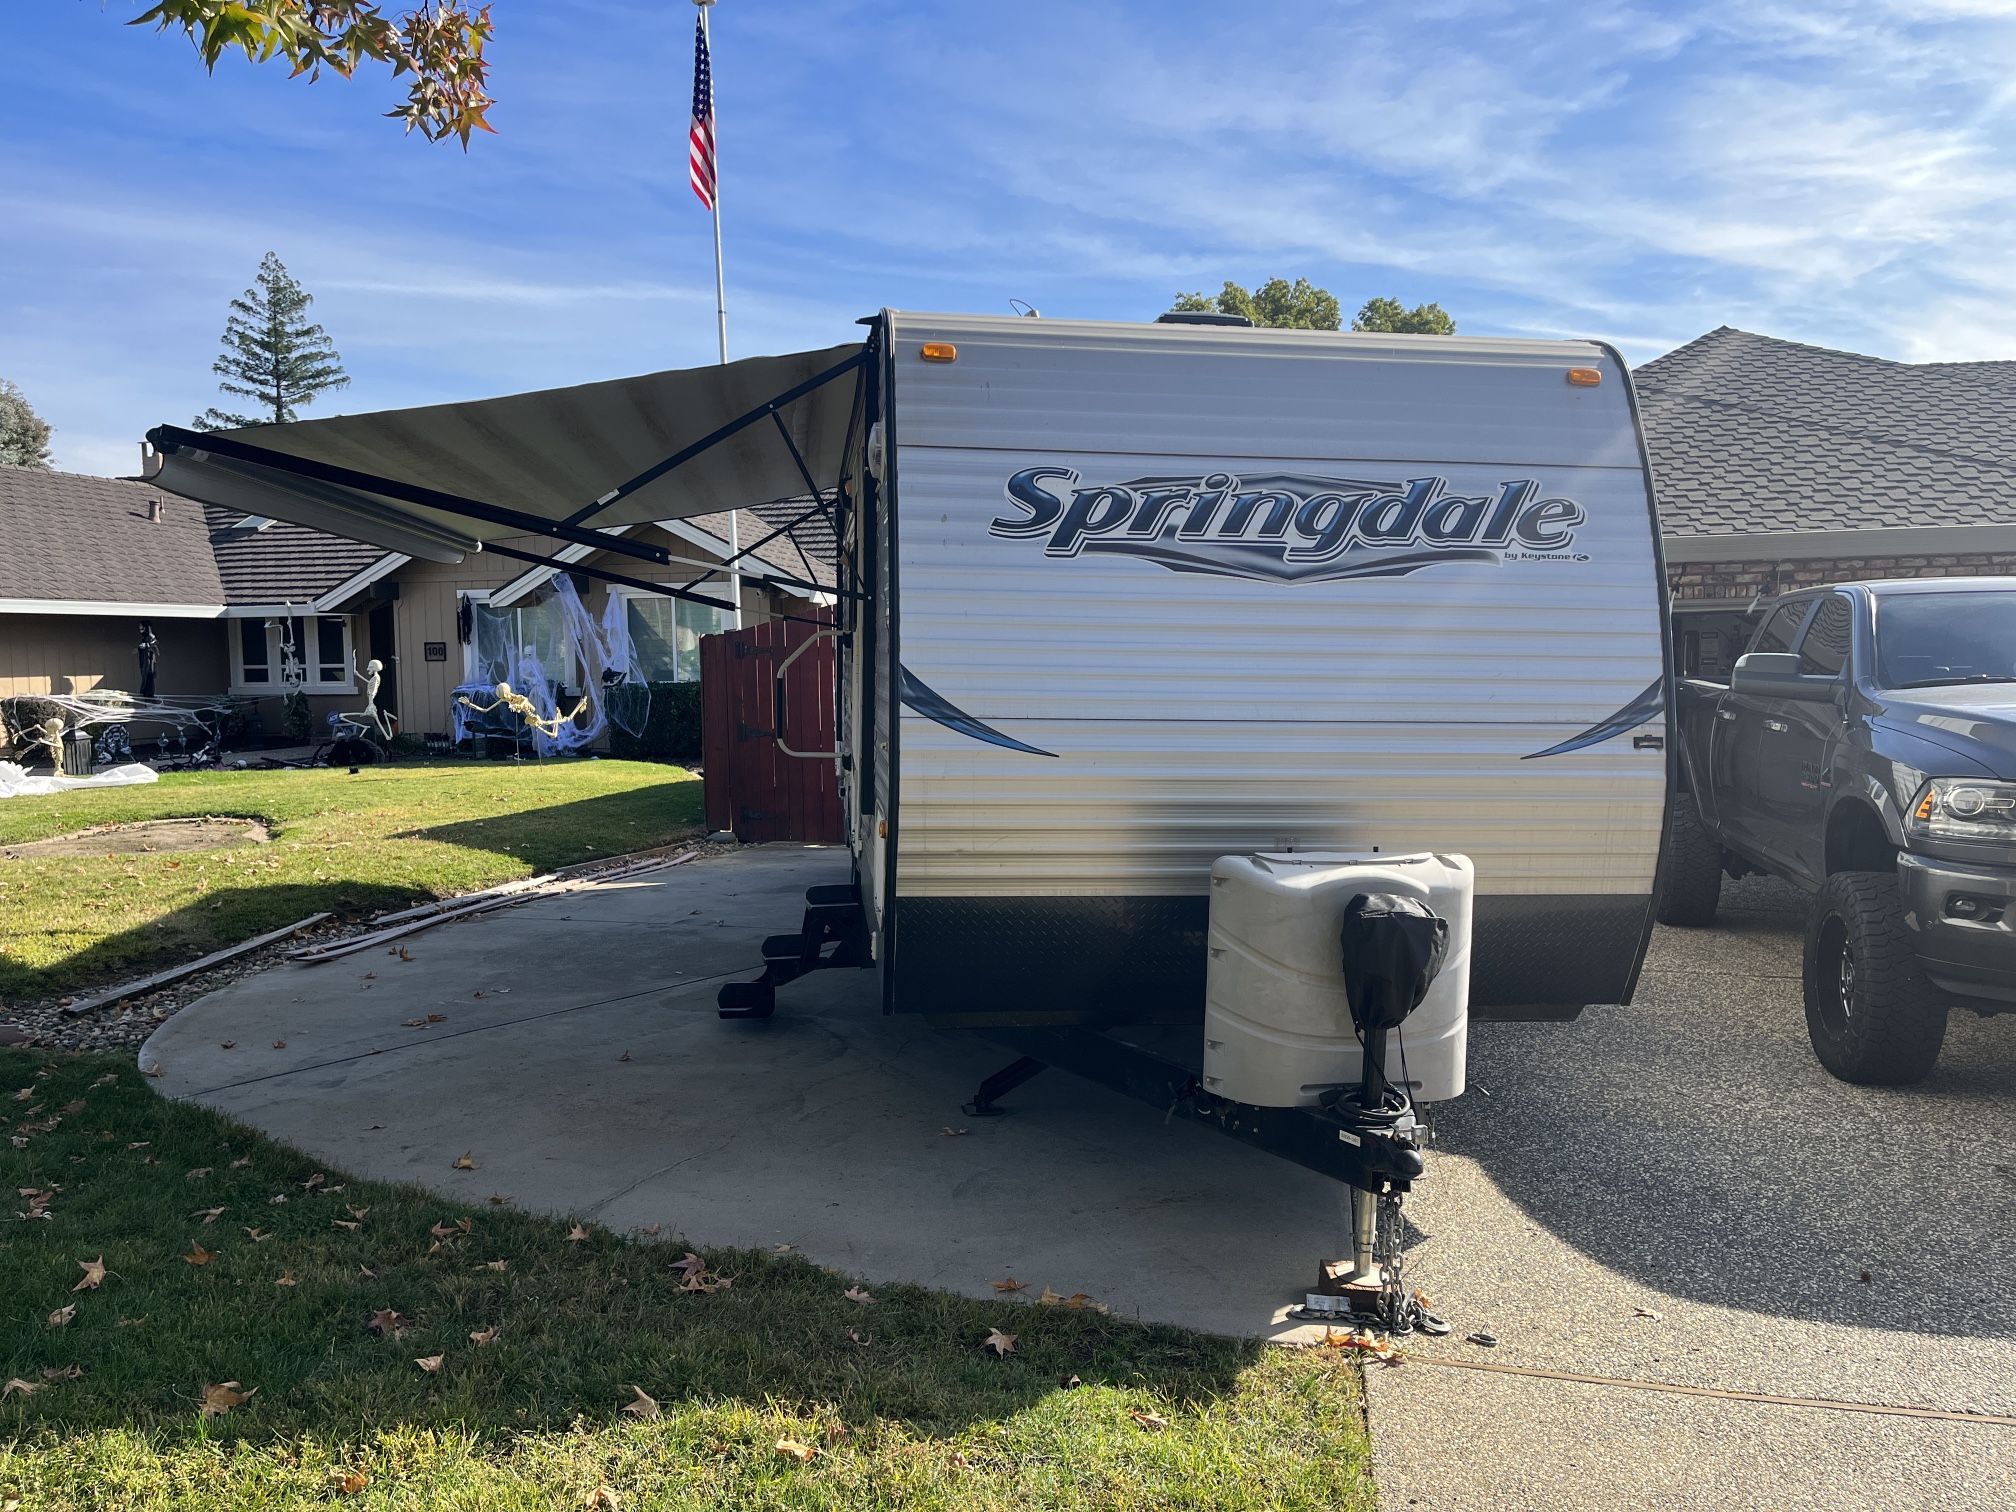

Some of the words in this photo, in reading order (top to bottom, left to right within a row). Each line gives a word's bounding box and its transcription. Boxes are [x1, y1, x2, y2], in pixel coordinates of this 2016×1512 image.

[988, 466, 1585, 564] Springdale
[1504, 552, 1518, 560] by
[1521, 552, 1571, 561] Keystone
